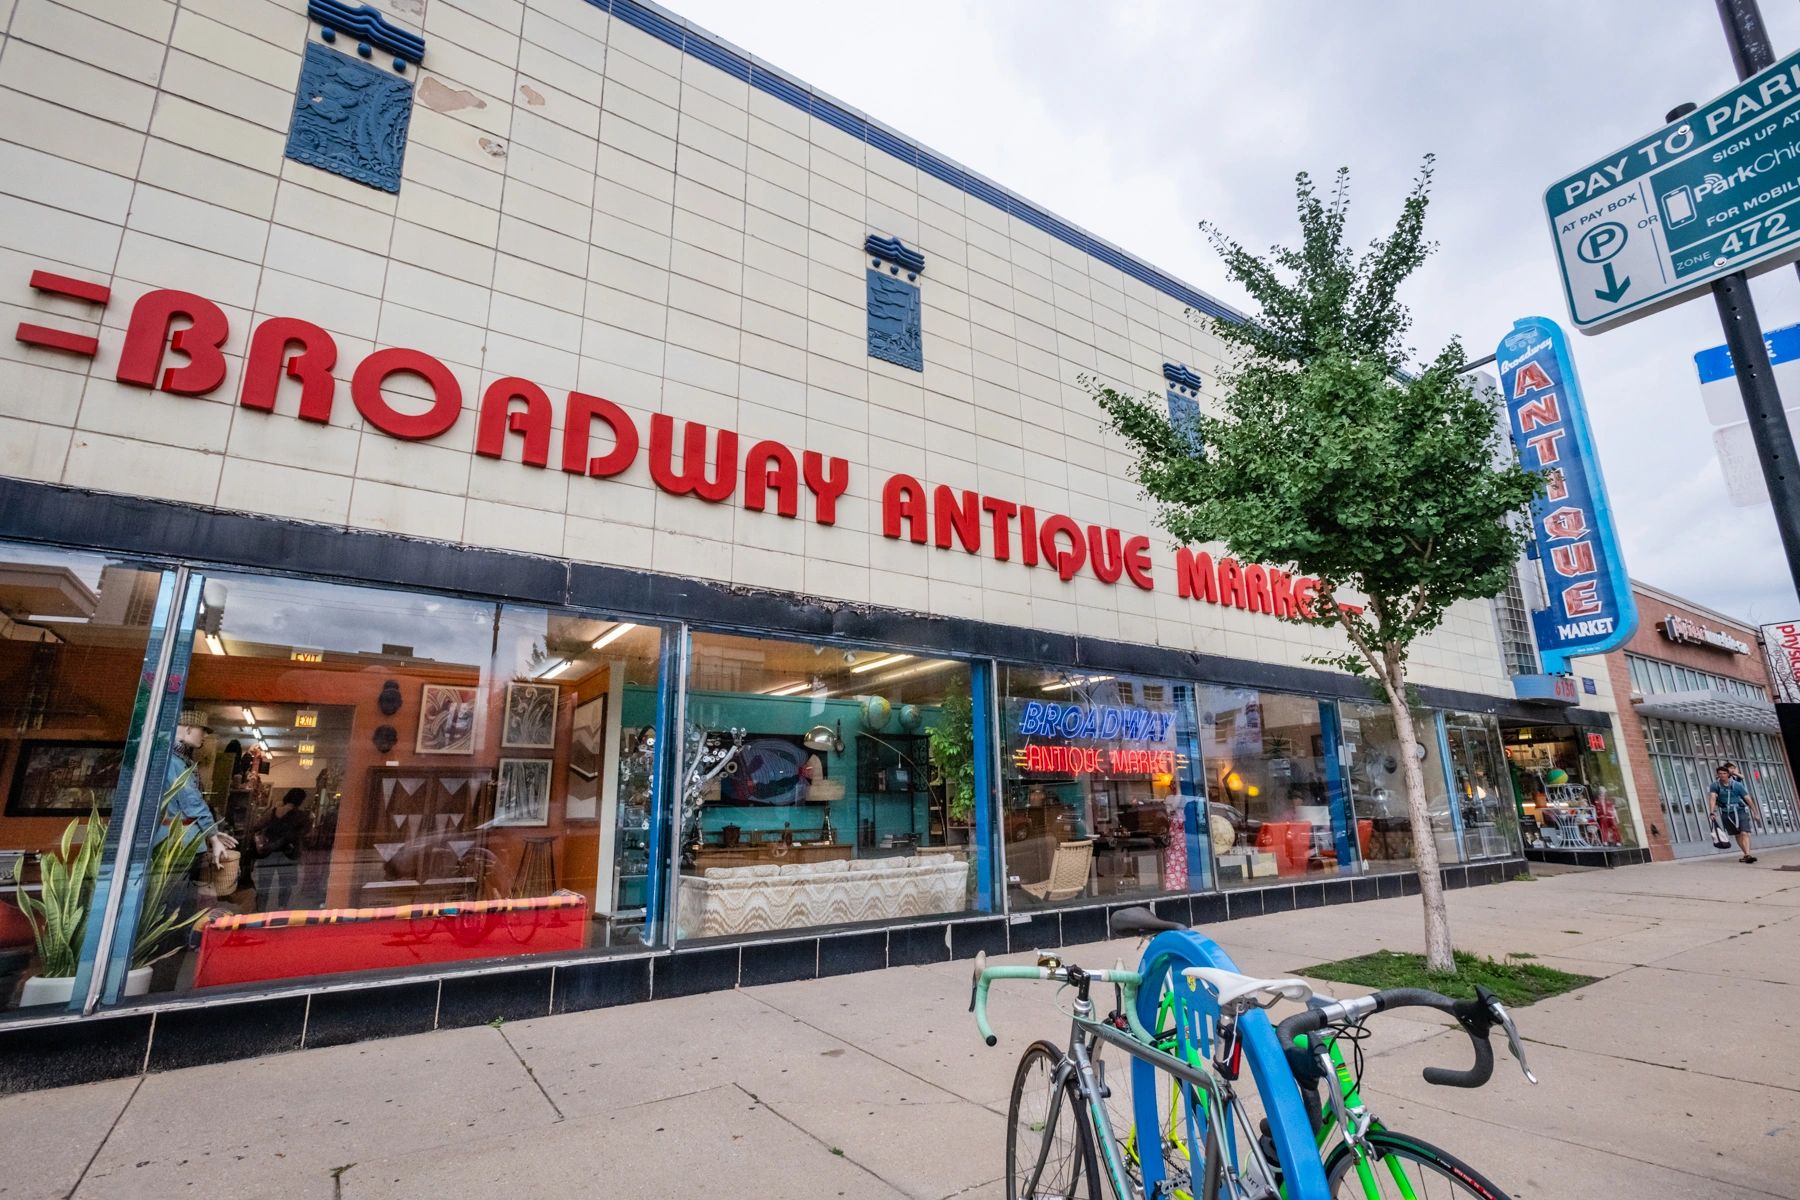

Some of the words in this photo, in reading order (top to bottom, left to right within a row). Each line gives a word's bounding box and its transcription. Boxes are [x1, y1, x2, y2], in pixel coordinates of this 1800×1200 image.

[1712, 138, 1750, 163] SIGN
[1754, 124, 1778, 141] UP
[1563, 156, 1628, 206] PAY
[1638, 130, 1695, 166] TO
[1561, 221, 1579, 235] AT
[1580, 207, 1604, 226] PAY
[1607, 193, 1638, 213] BOX
[1637, 214, 1659, 230] OR
[1706, 207, 1740, 228] FOR
[1743, 175, 1800, 212] MOBIL
[1676, 251, 1711, 271] ZONE
[1720, 212, 1790, 254] 472
[1500, 337, 1553, 376] Broadway
[115, 288, 849, 526] BROADWAY
[882, 472, 1154, 591] ANTIQUE
[1176, 547, 1335, 620] MARKE
[1513, 360, 1603, 619] ANTIQUE
[1558, 617, 1614, 641] MARKET
[1019, 701, 1177, 742] BROADWAY
[1027, 744, 1105, 776] ANTIQUE
[1109, 749, 1175, 774] MARKET
